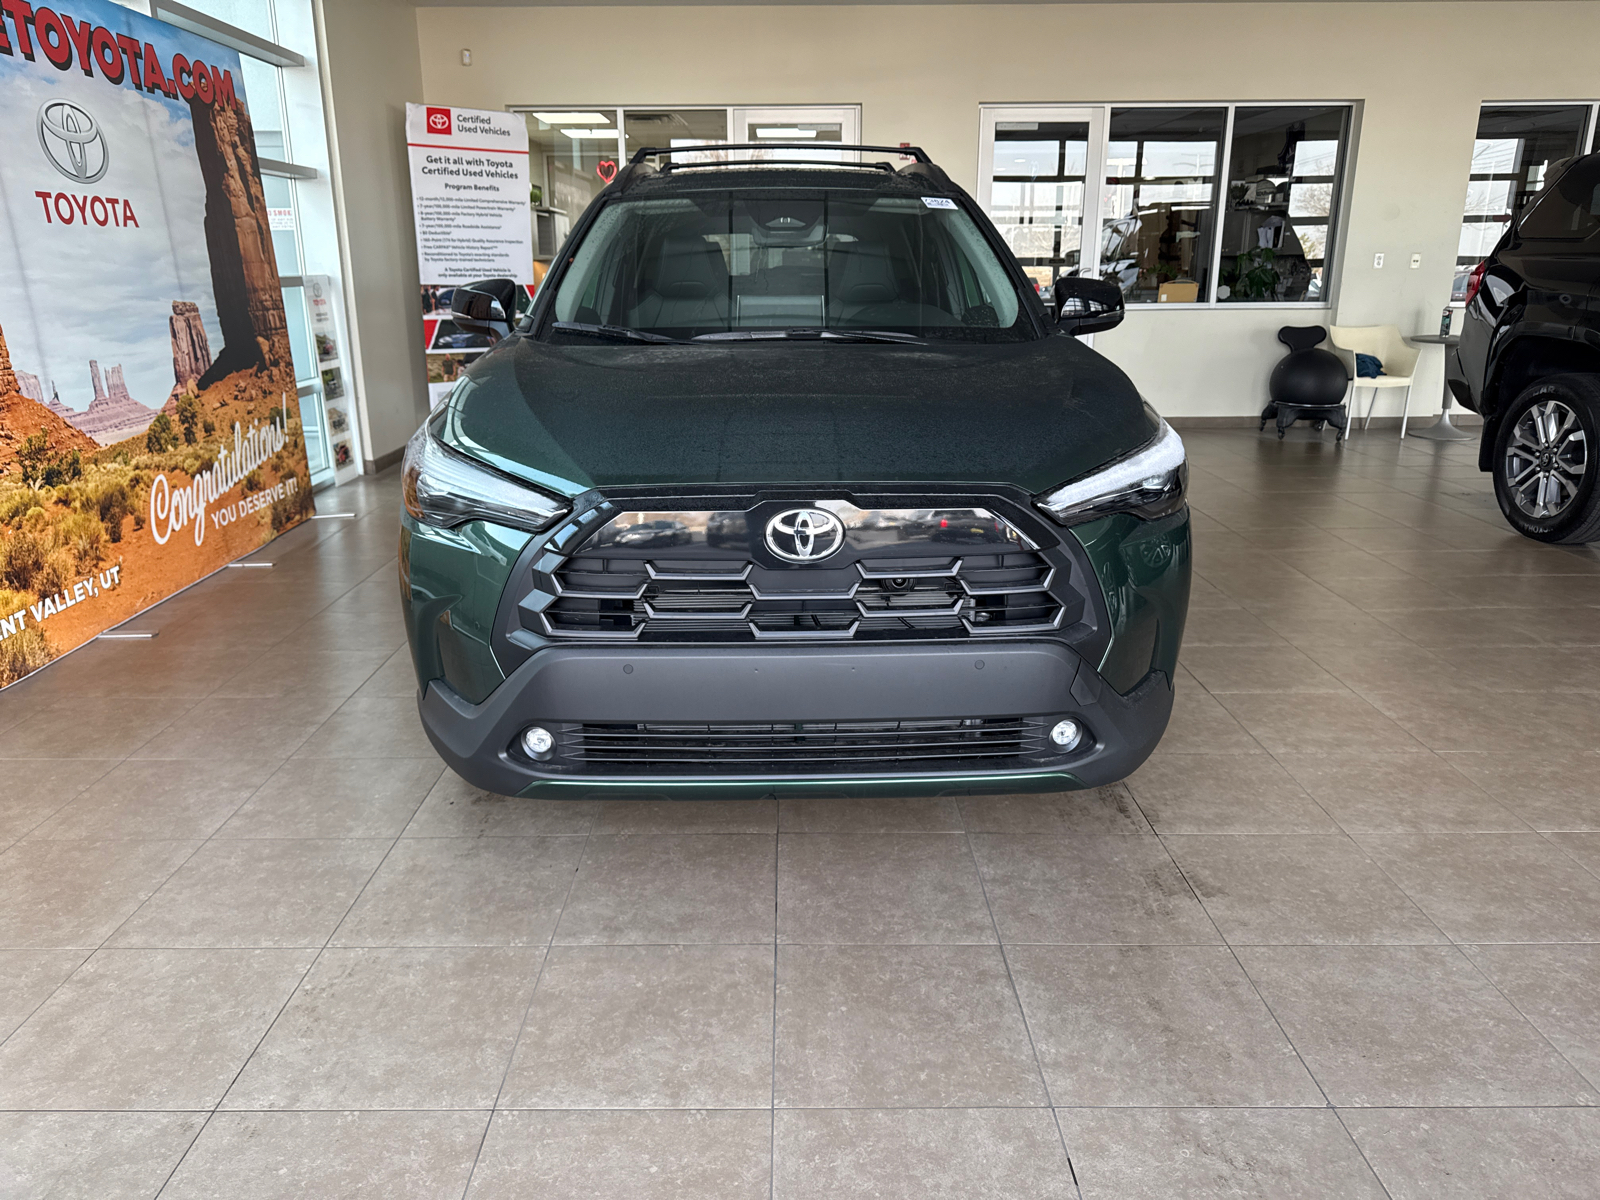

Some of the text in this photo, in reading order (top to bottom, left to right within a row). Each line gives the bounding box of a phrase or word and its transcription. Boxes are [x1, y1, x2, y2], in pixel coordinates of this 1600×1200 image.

[457, 114, 491, 125] Certified
[457, 124, 511, 137] Used Vehicles
[426, 155, 513, 169] Get it all with Toyota
[421, 166, 519, 180] Certified Used Vehicles
[444, 182, 500, 192] Program Benefits
[34, 190, 140, 228] TOYOTA
[150, 391, 290, 546] Congratulations!
[211, 477, 299, 529] YOU DESERVE IT!
[0, 565, 121, 641] NT VALLEY, UT
